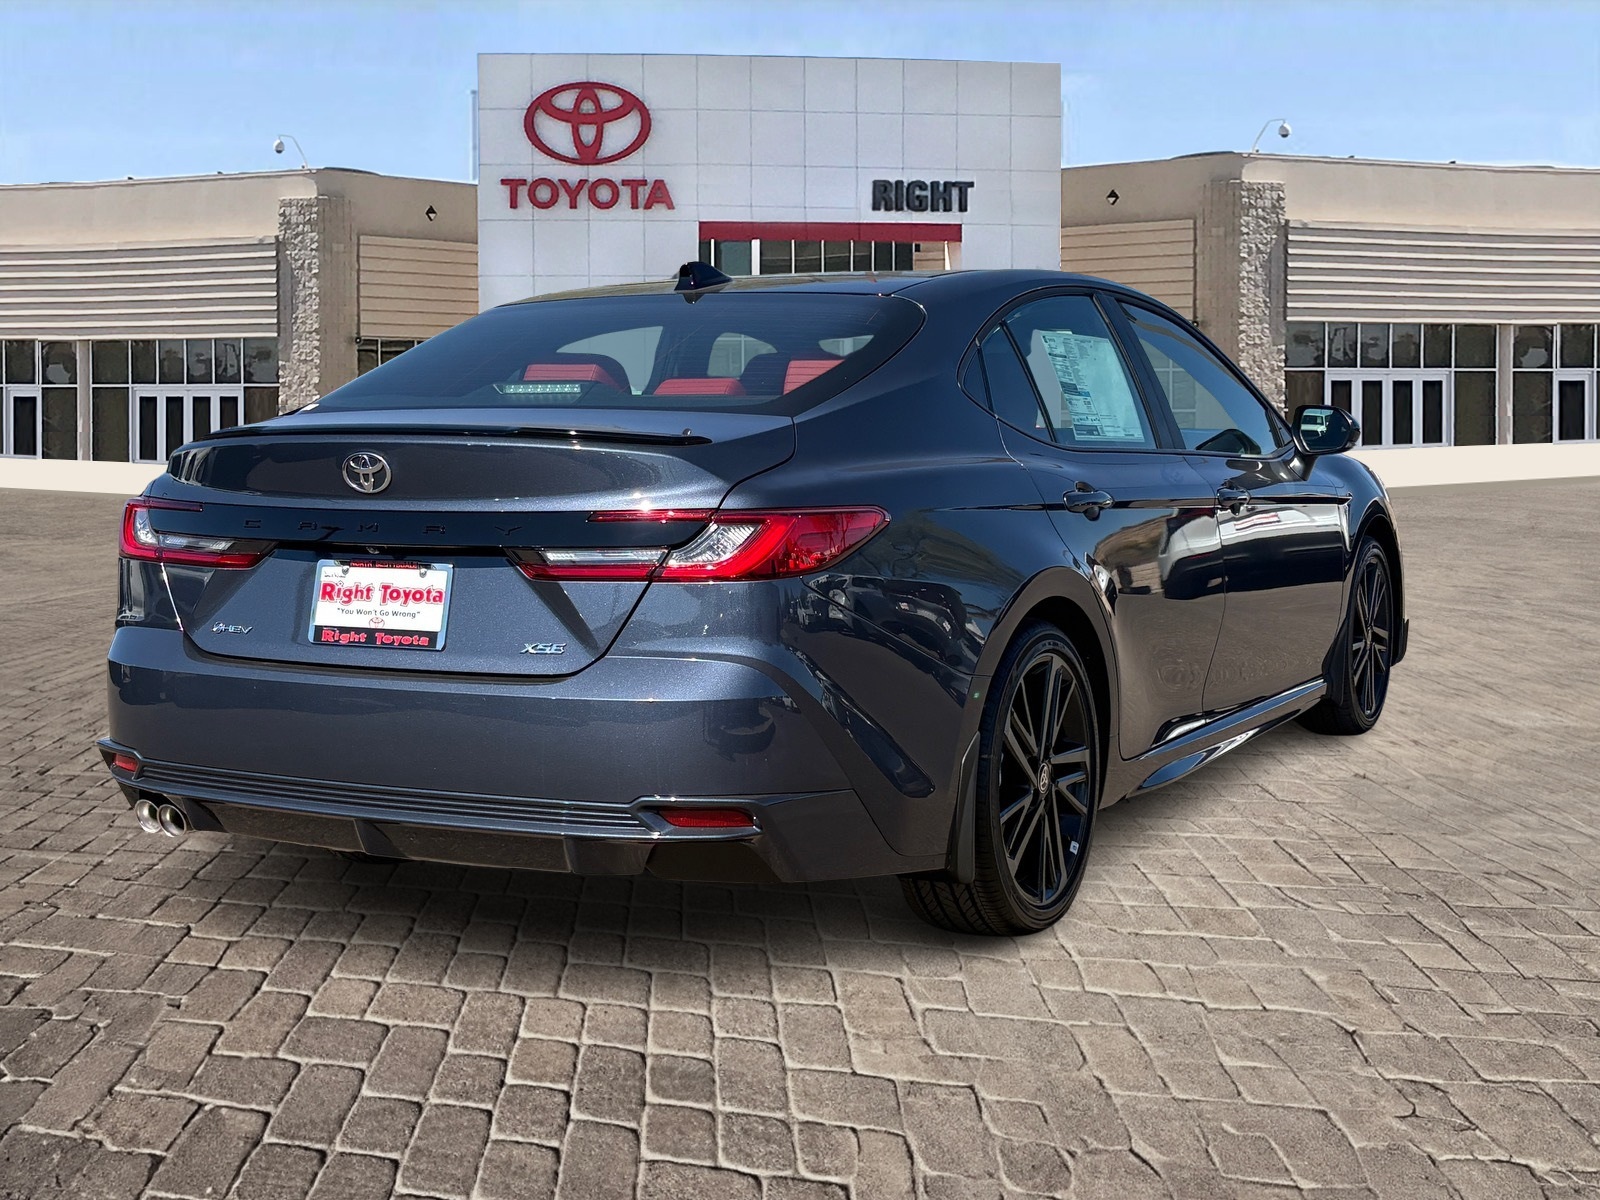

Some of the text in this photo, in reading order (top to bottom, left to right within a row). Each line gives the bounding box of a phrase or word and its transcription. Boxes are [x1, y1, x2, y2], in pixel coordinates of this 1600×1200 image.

[500, 178, 675, 210] TOYOTA
[871, 179, 975, 213] RIGHT
[243, 518, 523, 536] CAMRY
[320, 581, 445, 606] Right Toyota
[356, 608, 378, 617] Won't
[379, 609, 390, 618] Go
[321, 629, 430, 647] Right Toyota
[519, 642, 567, 655] XSE
